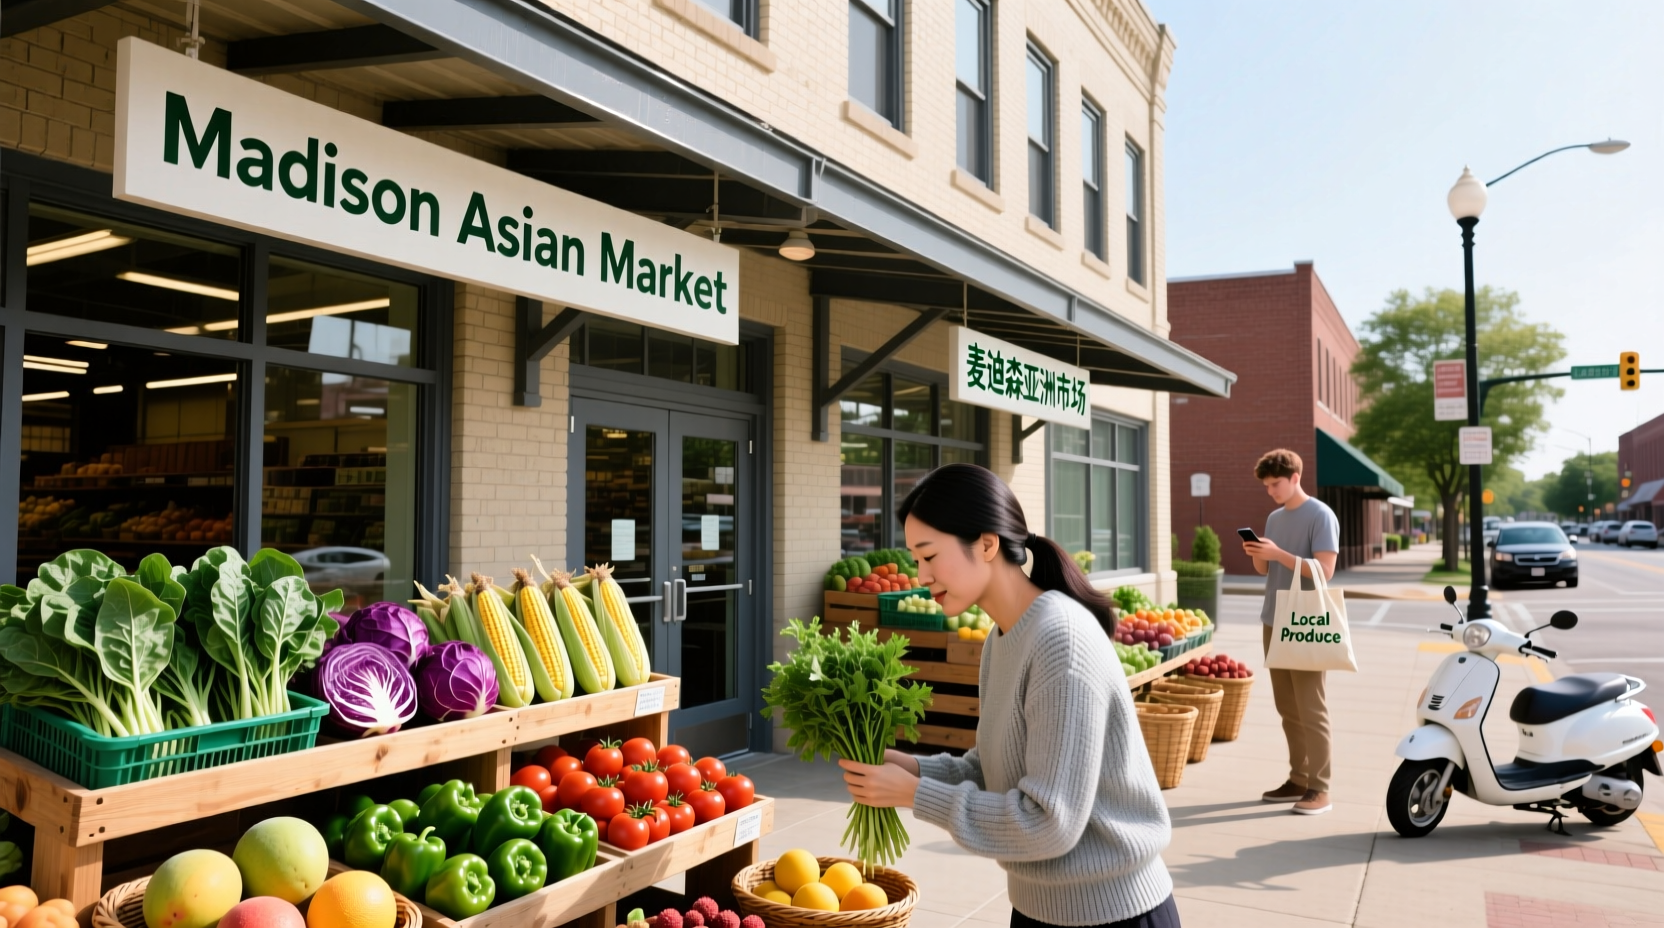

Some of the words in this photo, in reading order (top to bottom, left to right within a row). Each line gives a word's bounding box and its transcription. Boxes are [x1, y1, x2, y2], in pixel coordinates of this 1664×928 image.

[163, 91, 440, 237] Madison
[457, 191, 585, 276] Asian
[600, 231, 728, 315] Market
[967, 342, 1086, 416] 麦迪森亚洲市场
[1280, 626, 1342, 644] Produce
[1290, 611, 1330, 626] Local
